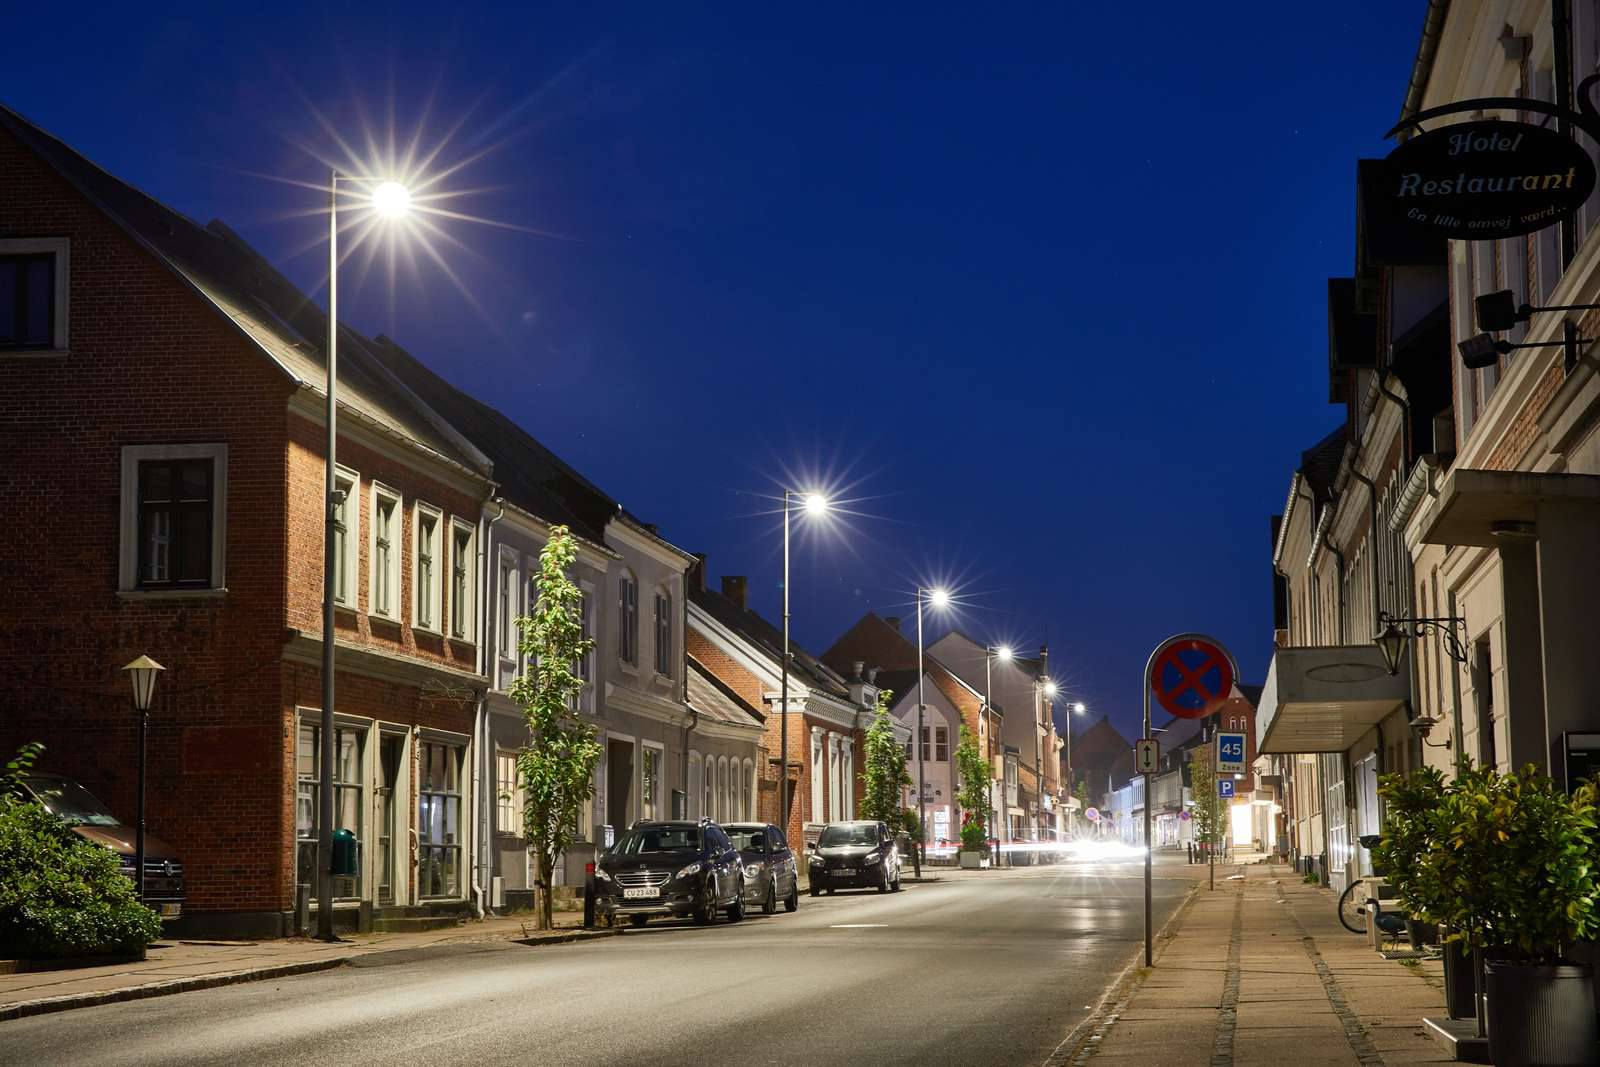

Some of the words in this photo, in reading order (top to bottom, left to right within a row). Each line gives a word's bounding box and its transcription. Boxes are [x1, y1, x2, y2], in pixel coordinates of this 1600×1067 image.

[1448, 131, 1524, 156] Hotel
[1397, 166, 1576, 197] Restaurant
[1407, 208, 1427, 222] En
[1434, 213, 1460, 228] lille
[1468, 216, 1511, 230] omvej
[1222, 743, 1241, 755] 45
[1222, 782, 1231, 794] P
